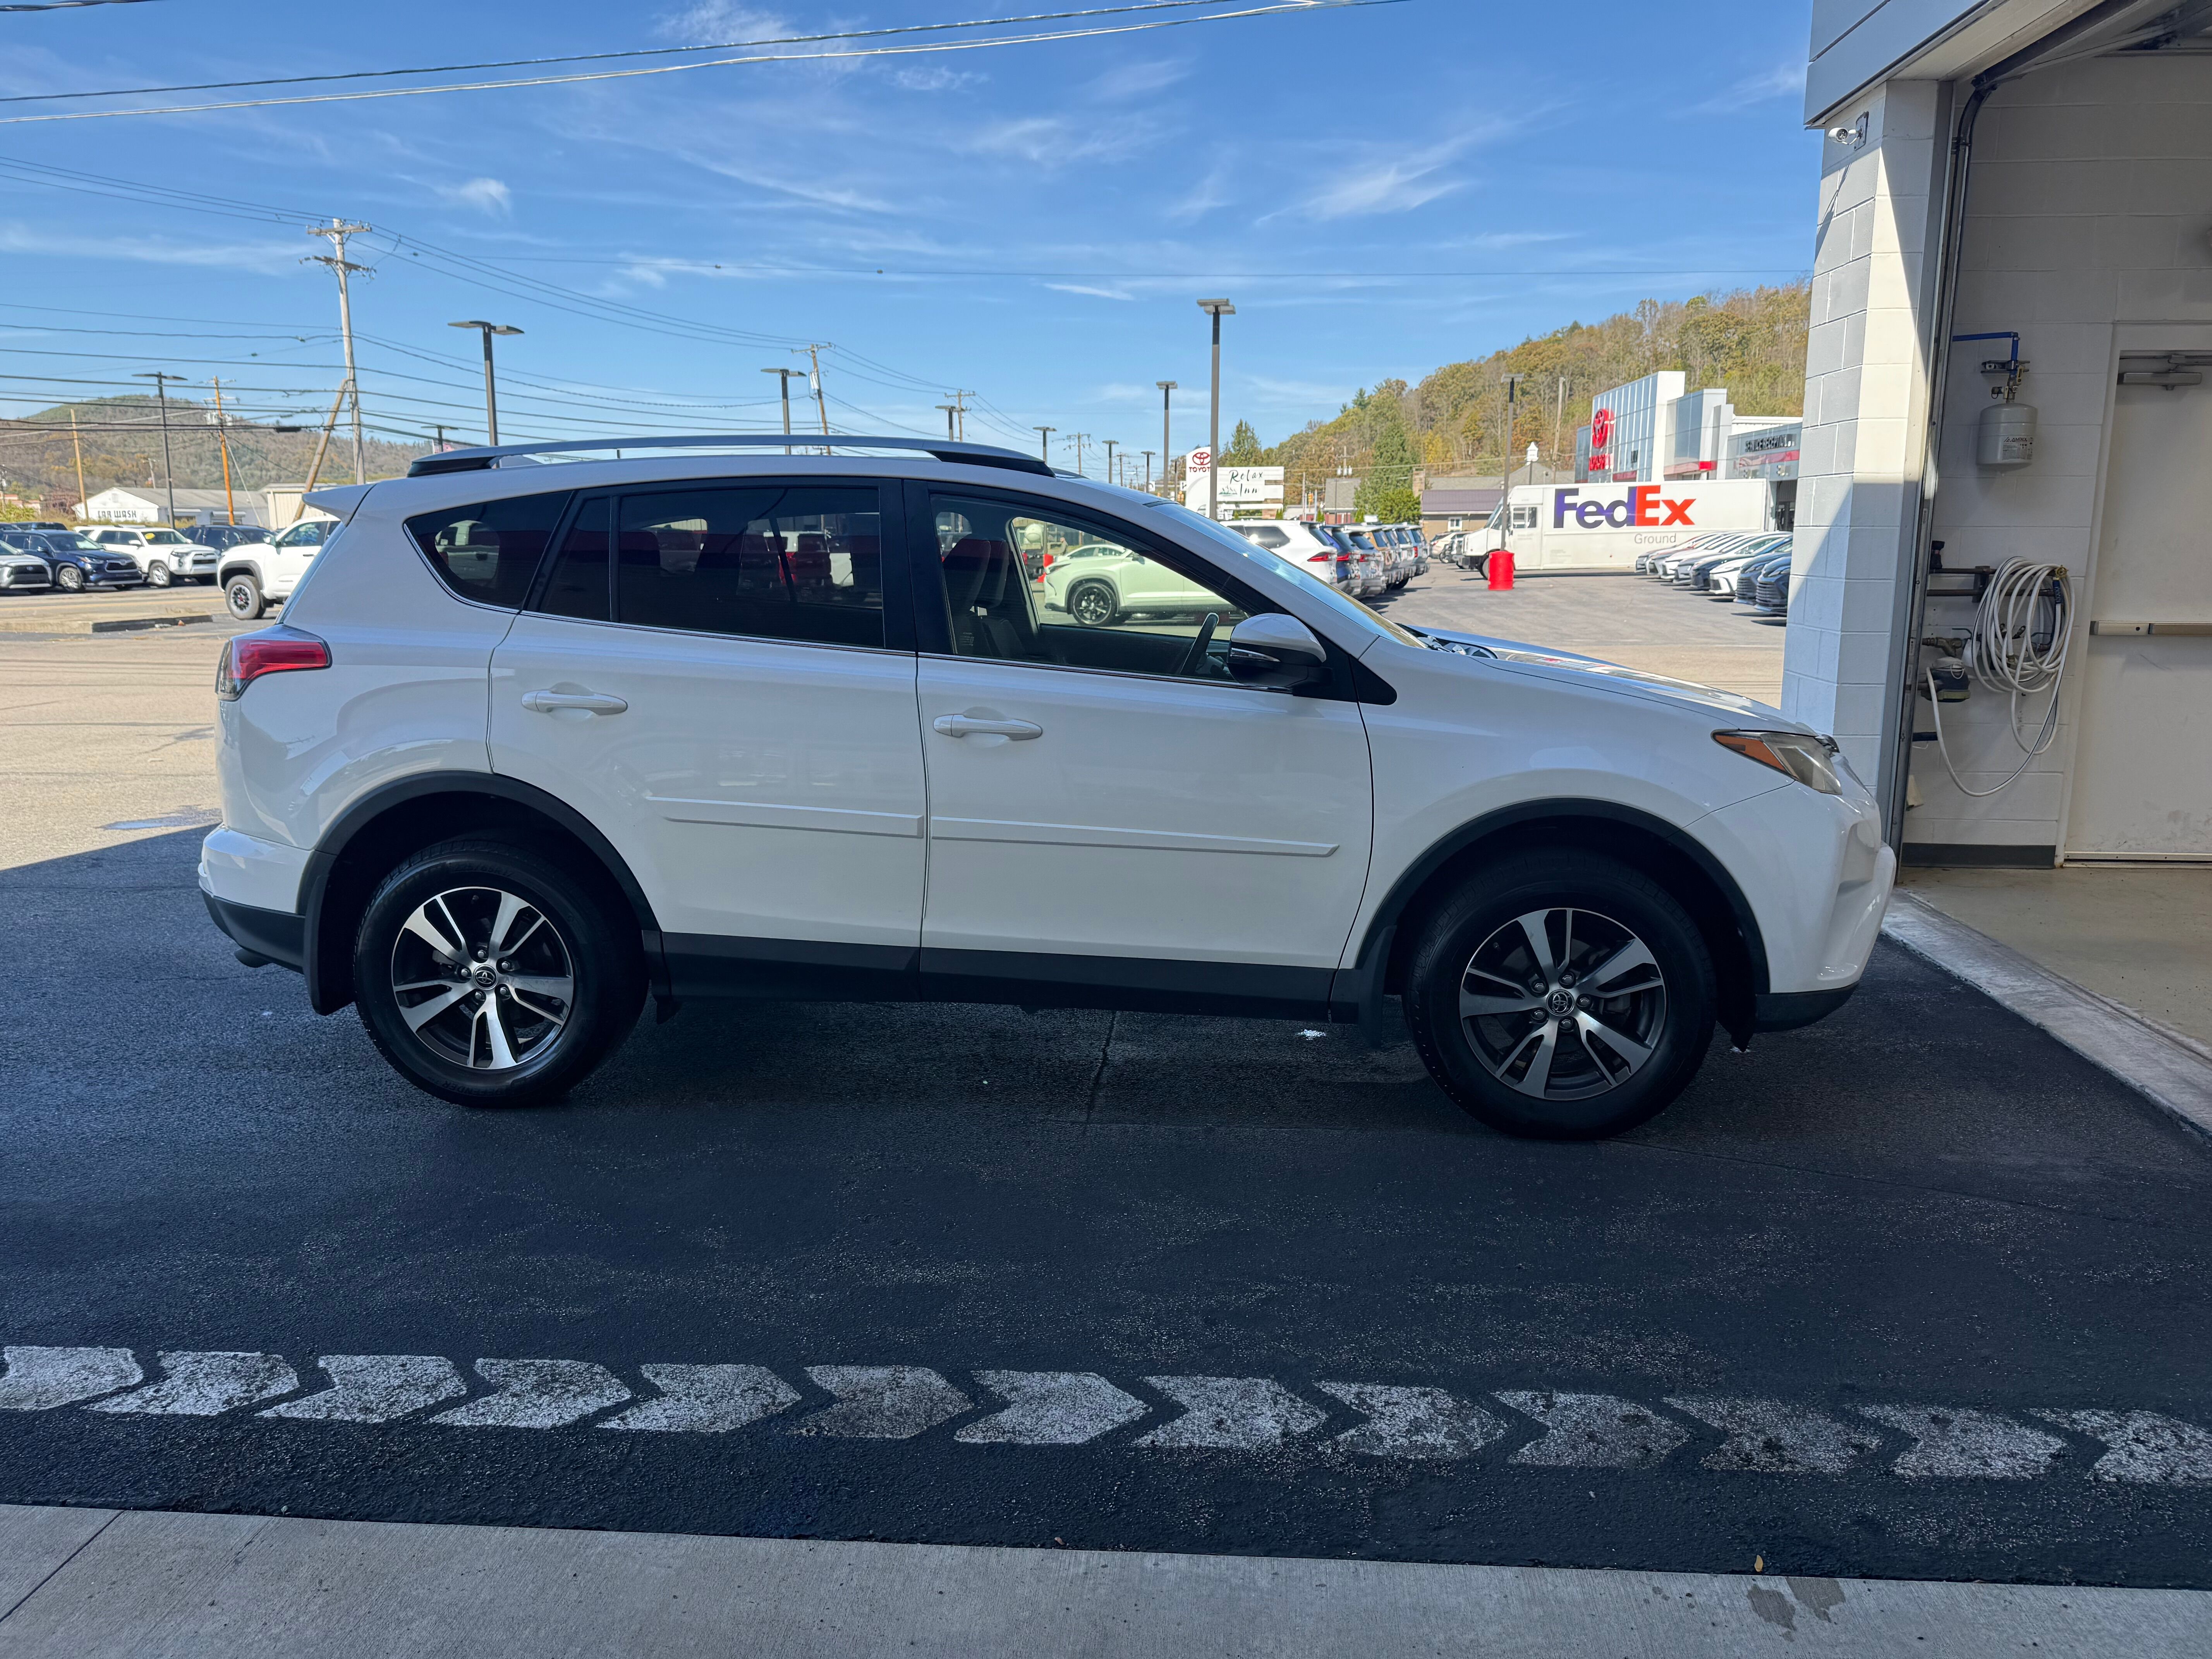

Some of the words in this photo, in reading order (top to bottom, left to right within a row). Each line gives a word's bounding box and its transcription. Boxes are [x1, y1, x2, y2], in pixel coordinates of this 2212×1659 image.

[1229, 469, 1263, 484] Relax
[1240, 483, 1257, 496] Inn
[1554, 485, 1696, 529] FedEx
[1634, 533, 1676, 544] Ground
